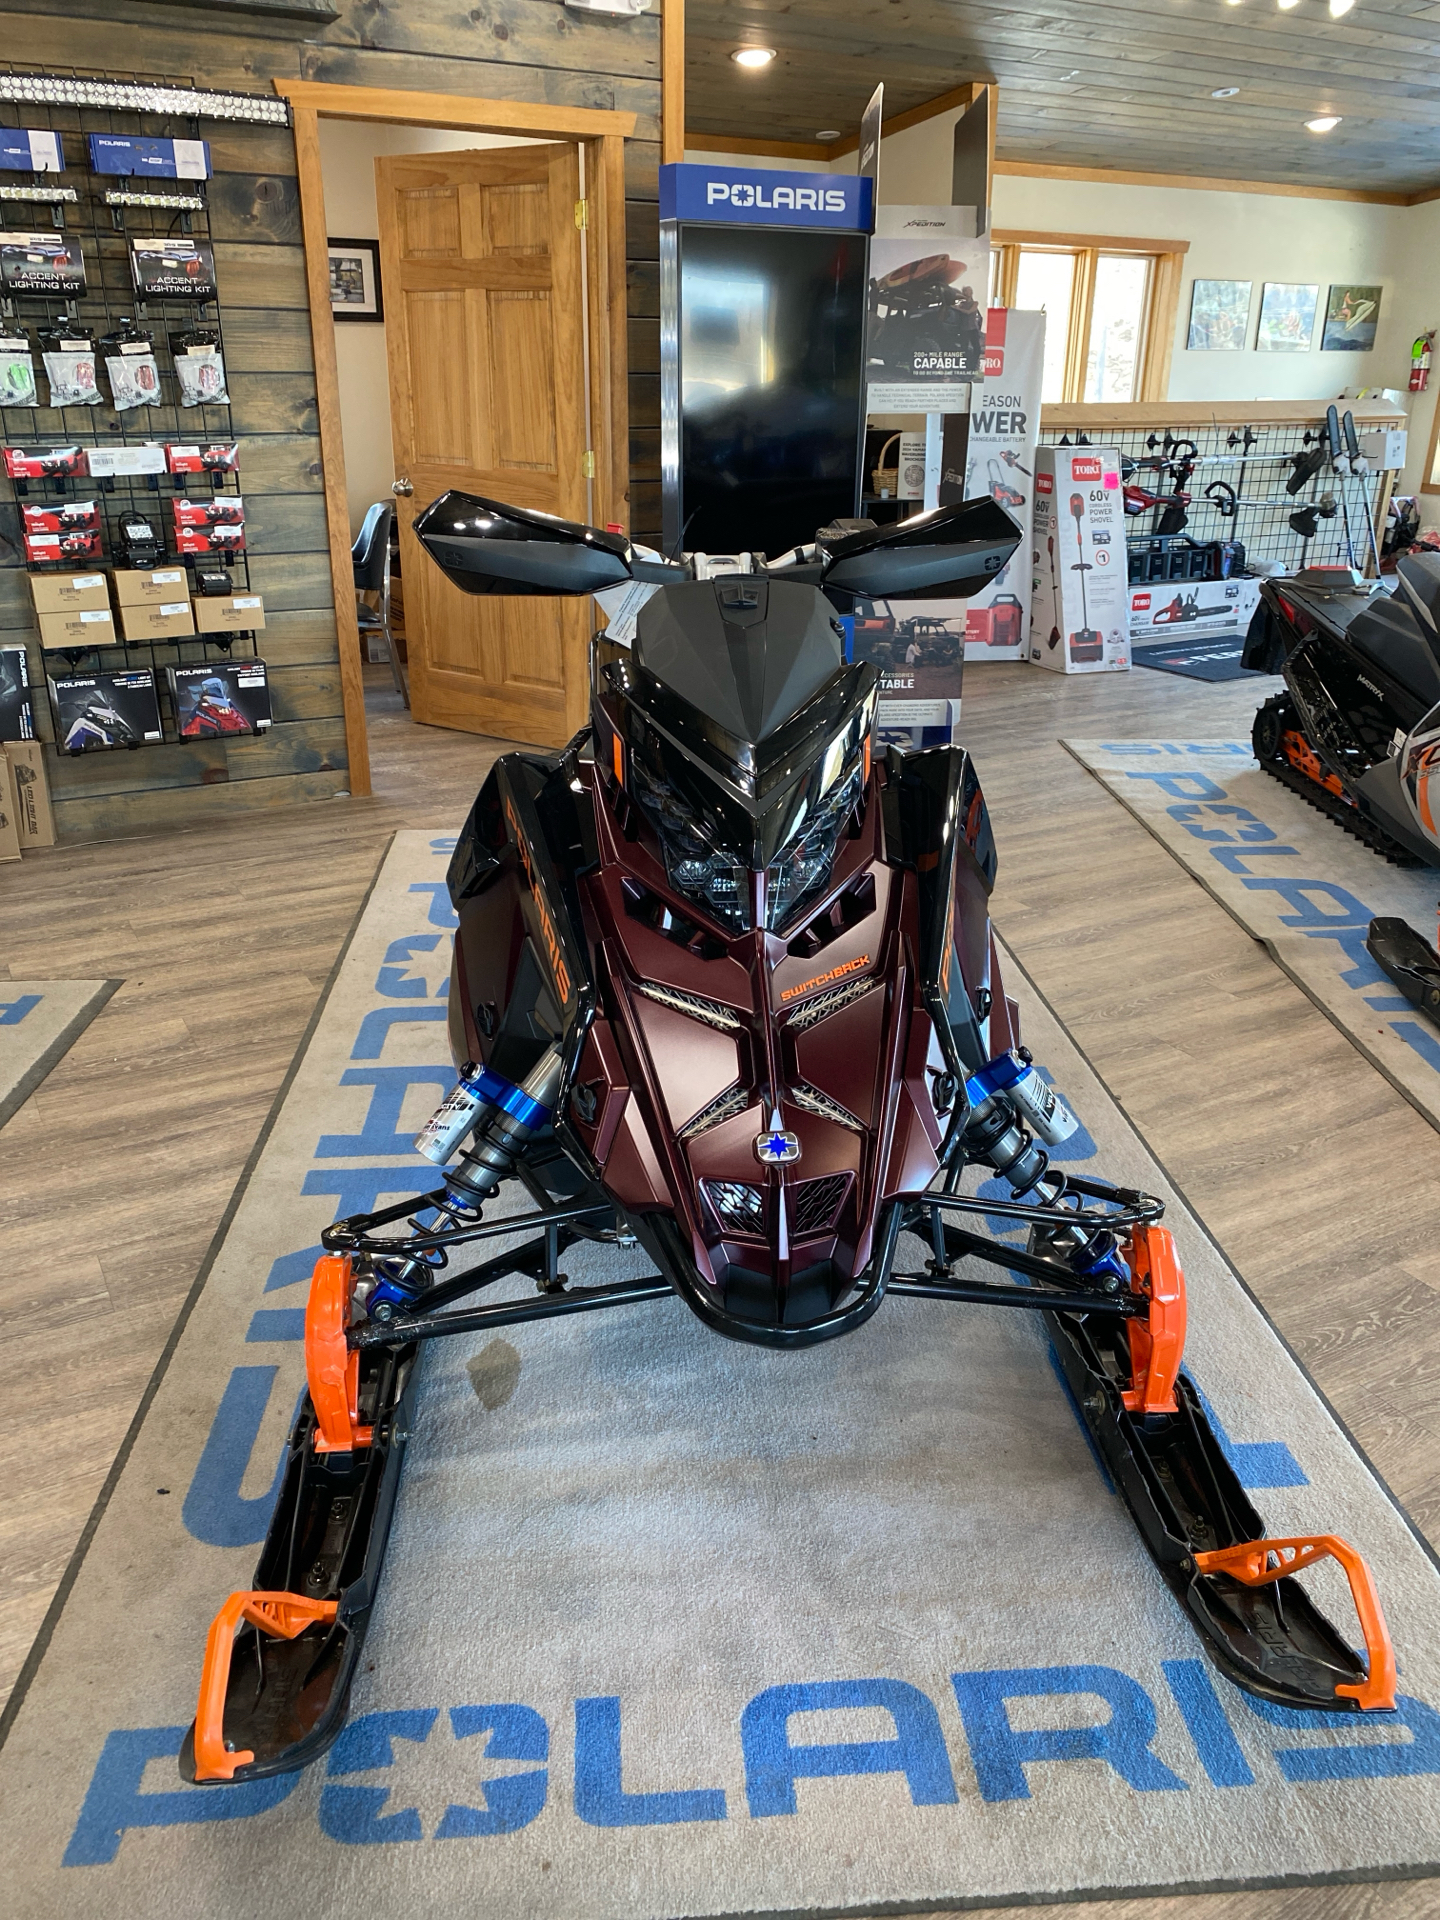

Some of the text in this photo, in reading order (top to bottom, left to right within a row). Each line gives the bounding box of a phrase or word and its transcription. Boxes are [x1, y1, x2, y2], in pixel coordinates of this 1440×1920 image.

[707, 182, 846, 212] POLARIS
[903, 219, 946, 229] XPEDITION
[21, 272, 66, 280] ACCENT
[157, 276, 198, 284] ACCENT
[8, 281, 80, 290] LIGHTING KIT
[145, 284, 211, 294] LIGHTING KIT
[914, 358, 967, 369] CAPABLE
[982, 395, 1021, 408] EASON
[972, 411, 1026, 434] WER
[1038, 480, 1052, 488] TORO
[18, 651, 28, 688] POLARIS
[176, 668, 213, 677] POLARIS
[57, 679, 96, 690] POLARIS
[880, 679, 915, 689] TABLE
[1356, 674, 1385, 702] MATRYX
[506, 795, 572, 1004] POLARIS
[780, 954, 871, 1002] SWITCHBACK
